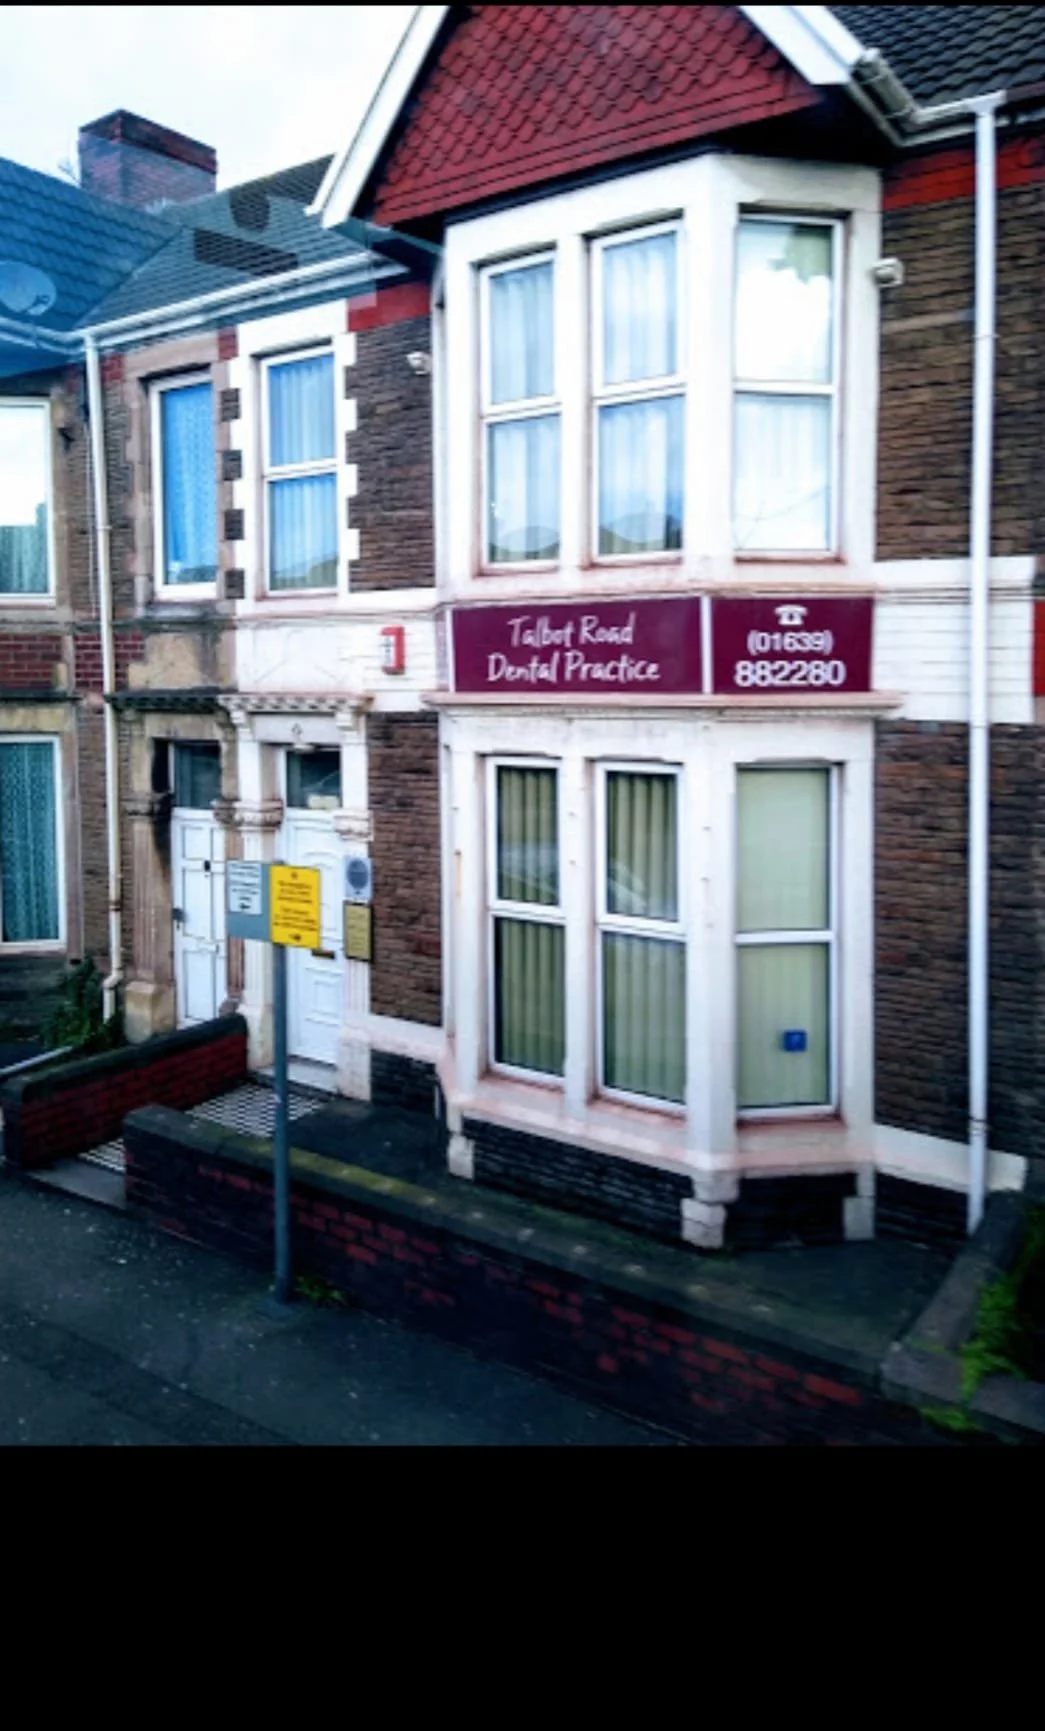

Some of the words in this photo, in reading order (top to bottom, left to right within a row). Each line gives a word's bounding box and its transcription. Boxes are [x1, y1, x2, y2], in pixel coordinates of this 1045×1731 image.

[508, 616, 574, 648] Talbot
[579, 612, 634, 646] Road
[748, 631, 833, 656] (01639)
[488, 652, 557, 684] Dental
[564, 650, 661, 682] Practice
[735, 660, 846, 687] 882280
